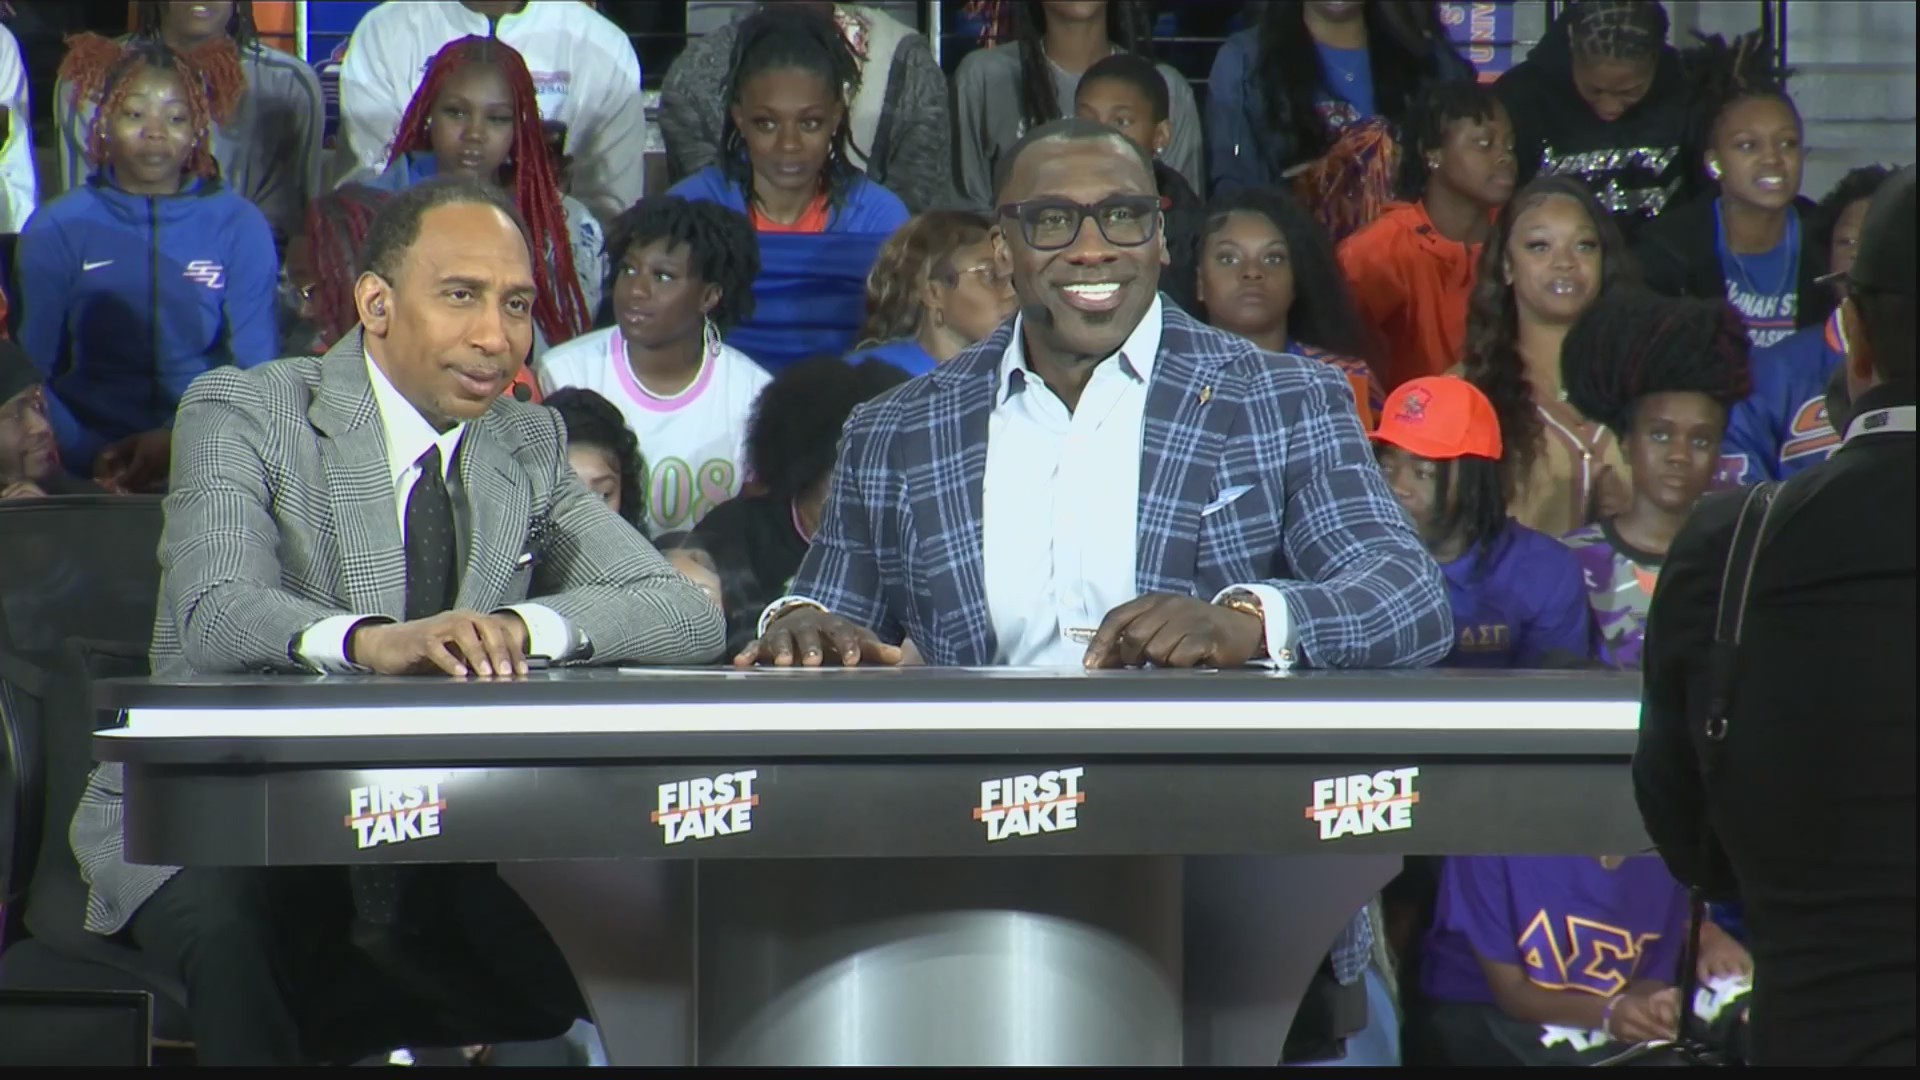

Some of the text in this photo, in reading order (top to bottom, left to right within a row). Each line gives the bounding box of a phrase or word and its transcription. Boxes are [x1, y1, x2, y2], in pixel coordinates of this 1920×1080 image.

[641, 456, 736, 529] 08
[350, 776, 444, 819] FIRST
[658, 769, 757, 815] FIRST
[981, 766, 1084, 811] FIRST
[1313, 766, 1420, 810] FIRST
[351, 805, 441, 850] TAKE
[658, 801, 752, 845] TAKE
[981, 798, 1078, 841] TAKE
[1313, 798, 1413, 840] TAKE
